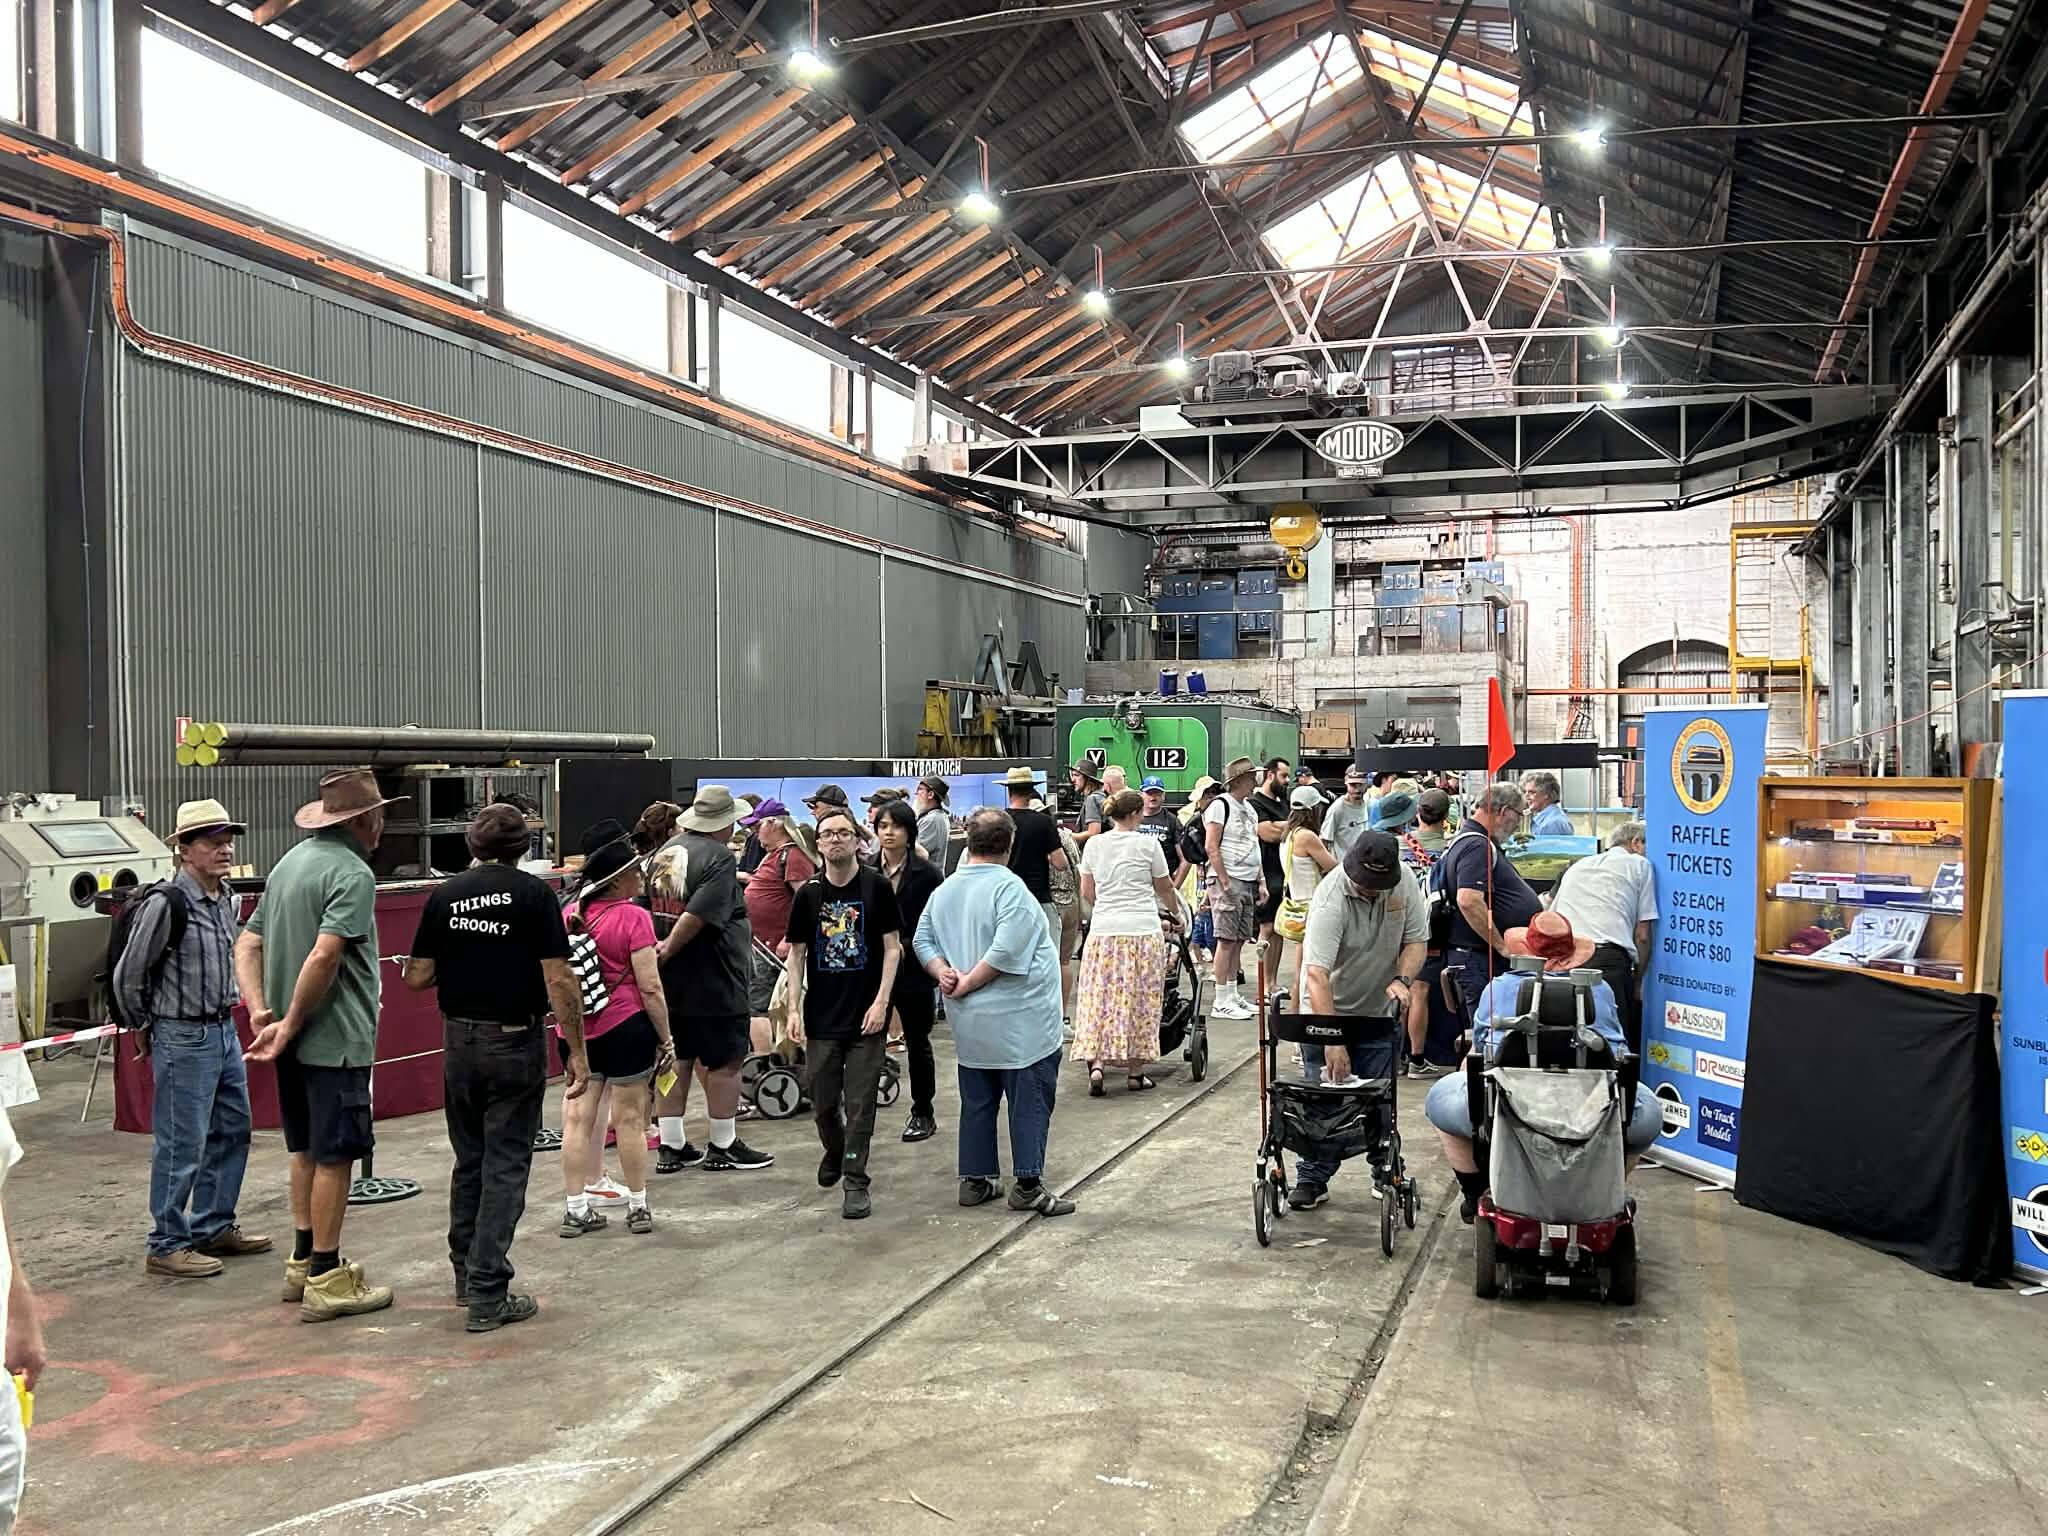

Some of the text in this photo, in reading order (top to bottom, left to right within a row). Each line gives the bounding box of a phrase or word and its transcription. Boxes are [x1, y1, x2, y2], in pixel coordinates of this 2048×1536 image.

[1325, 426, 1394, 460] MOORE
[892, 760, 961, 777] MARYBOROUGH
[1153, 749, 1180, 767] 112
[1671, 825, 1731, 847] RAFFLE
[1667, 853, 1732, 877] TICKETS
[449, 892, 513, 915] THINGS
[1672, 890, 1725, 912] $2 EACH
[449, 916, 511, 936] CROOK?
[1670, 915, 1723, 938] 3 FOR $5
[1663, 937, 1731, 963] 50 FOR $80
[1657, 973, 1737, 998] PRIZES DONATED BY:
[1665, 1104, 1688, 1118] JAMES
[1701, 1105, 1736, 1129] On Track
[1704, 1124, 1732, 1142] Models
[2016, 1203, 2045, 1221] WILL
